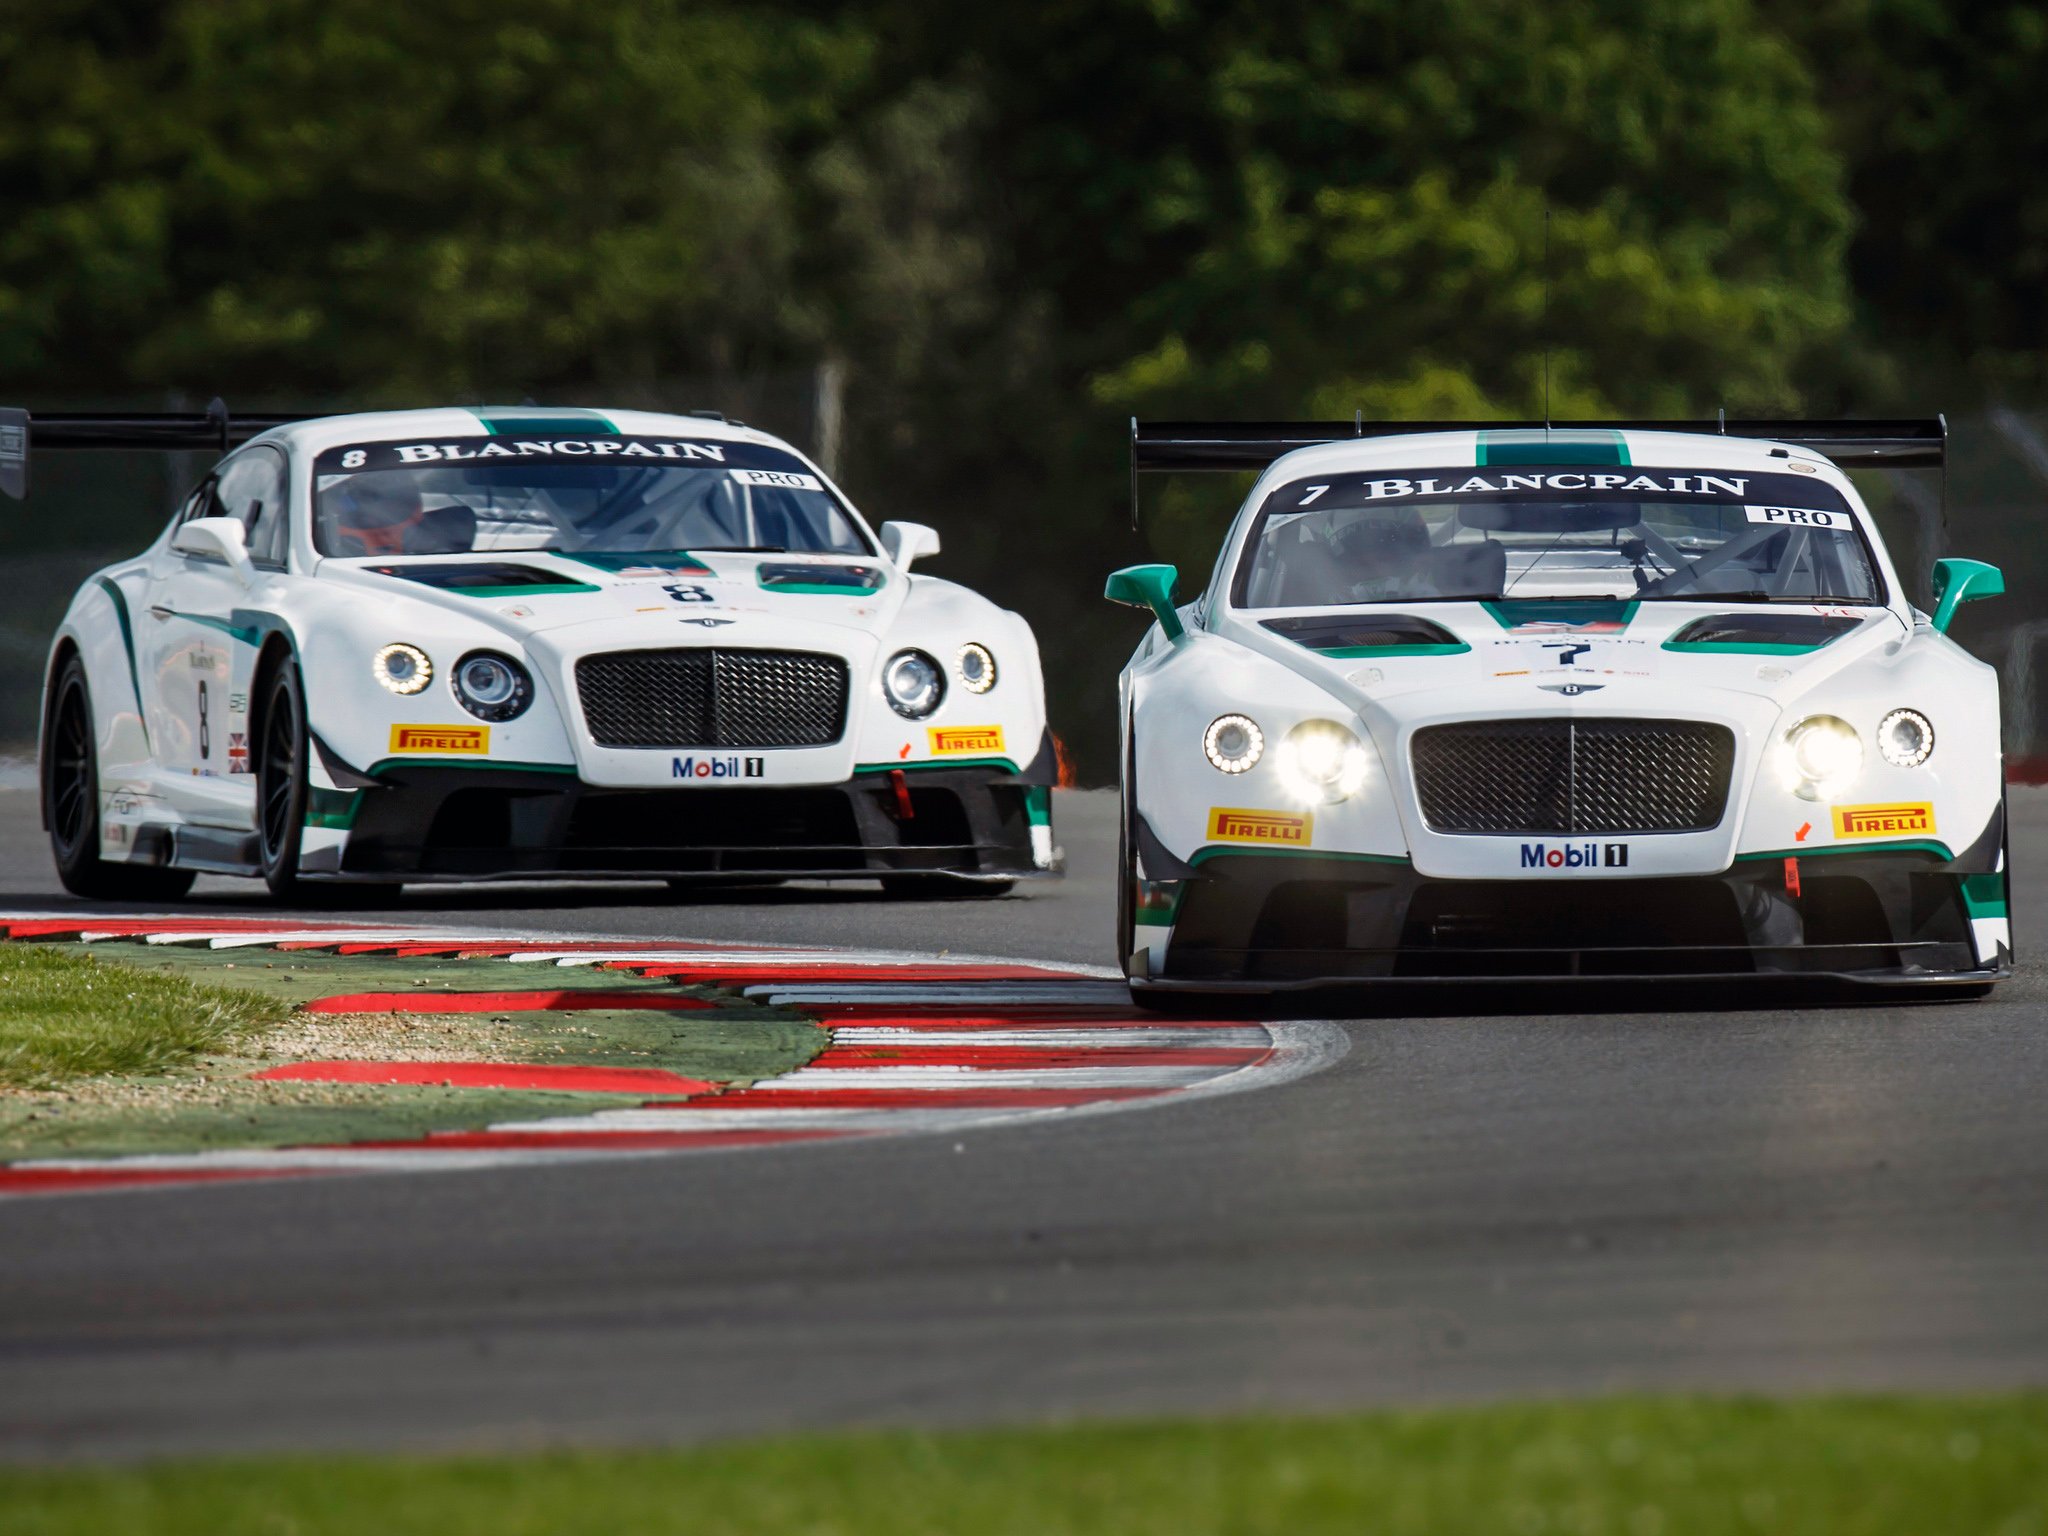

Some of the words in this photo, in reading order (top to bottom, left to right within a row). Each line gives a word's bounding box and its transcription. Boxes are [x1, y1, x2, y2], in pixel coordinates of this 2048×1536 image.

[341, 449, 367, 468] 8
[394, 441, 726, 463] BLANCPAIN
[747, 472, 806, 488] PRO
[1364, 474, 1749, 499] BLANCPAIN
[1298, 485, 1330, 505] 7
[1765, 508, 1833, 526] PRO
[661, 583, 714, 602] 8
[1542, 643, 1591, 665] 7
[199, 680, 209, 760] 8
[398, 729, 482, 749] PIRELLI
[936, 731, 999, 750] PIRELLI
[673, 757, 738, 777] Mobil
[1217, 814, 1304, 840] PIRELLI
[1843, 809, 1927, 832] PIRELLI
[1521, 844, 1597, 868] Mobil
